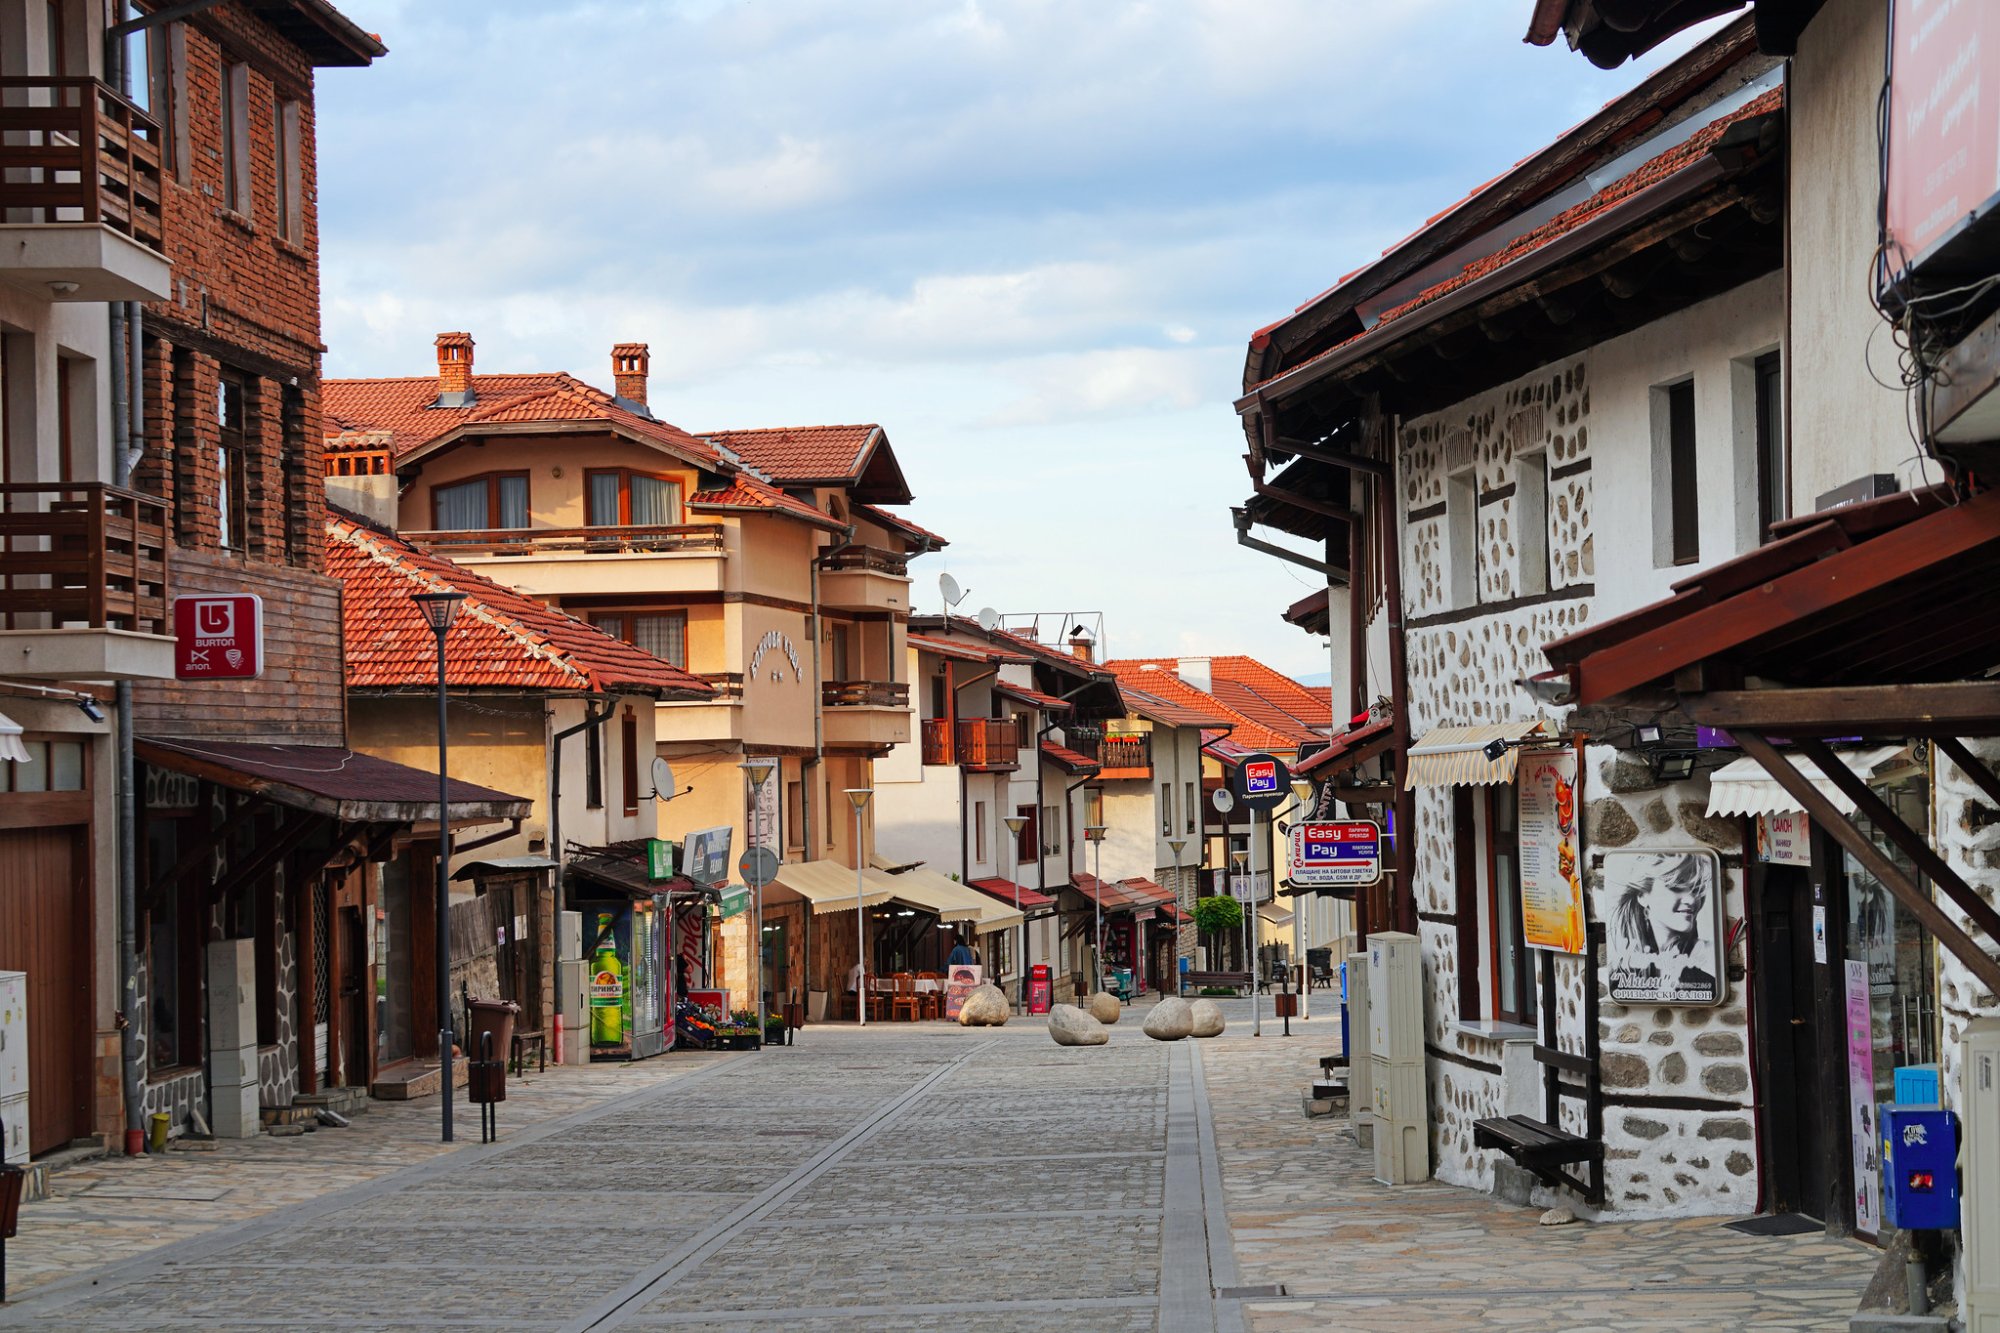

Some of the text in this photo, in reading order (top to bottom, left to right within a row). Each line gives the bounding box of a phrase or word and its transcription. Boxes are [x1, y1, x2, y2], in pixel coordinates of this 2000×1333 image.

[195, 638, 236, 647] BURTON
[1248, 767, 1274, 778] Easy
[1250, 778, 1269, 789] Pay
[1771, 818, 1793, 833] САЛОН
[1308, 828, 1341, 841] Easy
[1311, 844, 1338, 857] Pay
[1613, 990, 1713, 999] ФРИЗЬОРСКИ САЛОН
